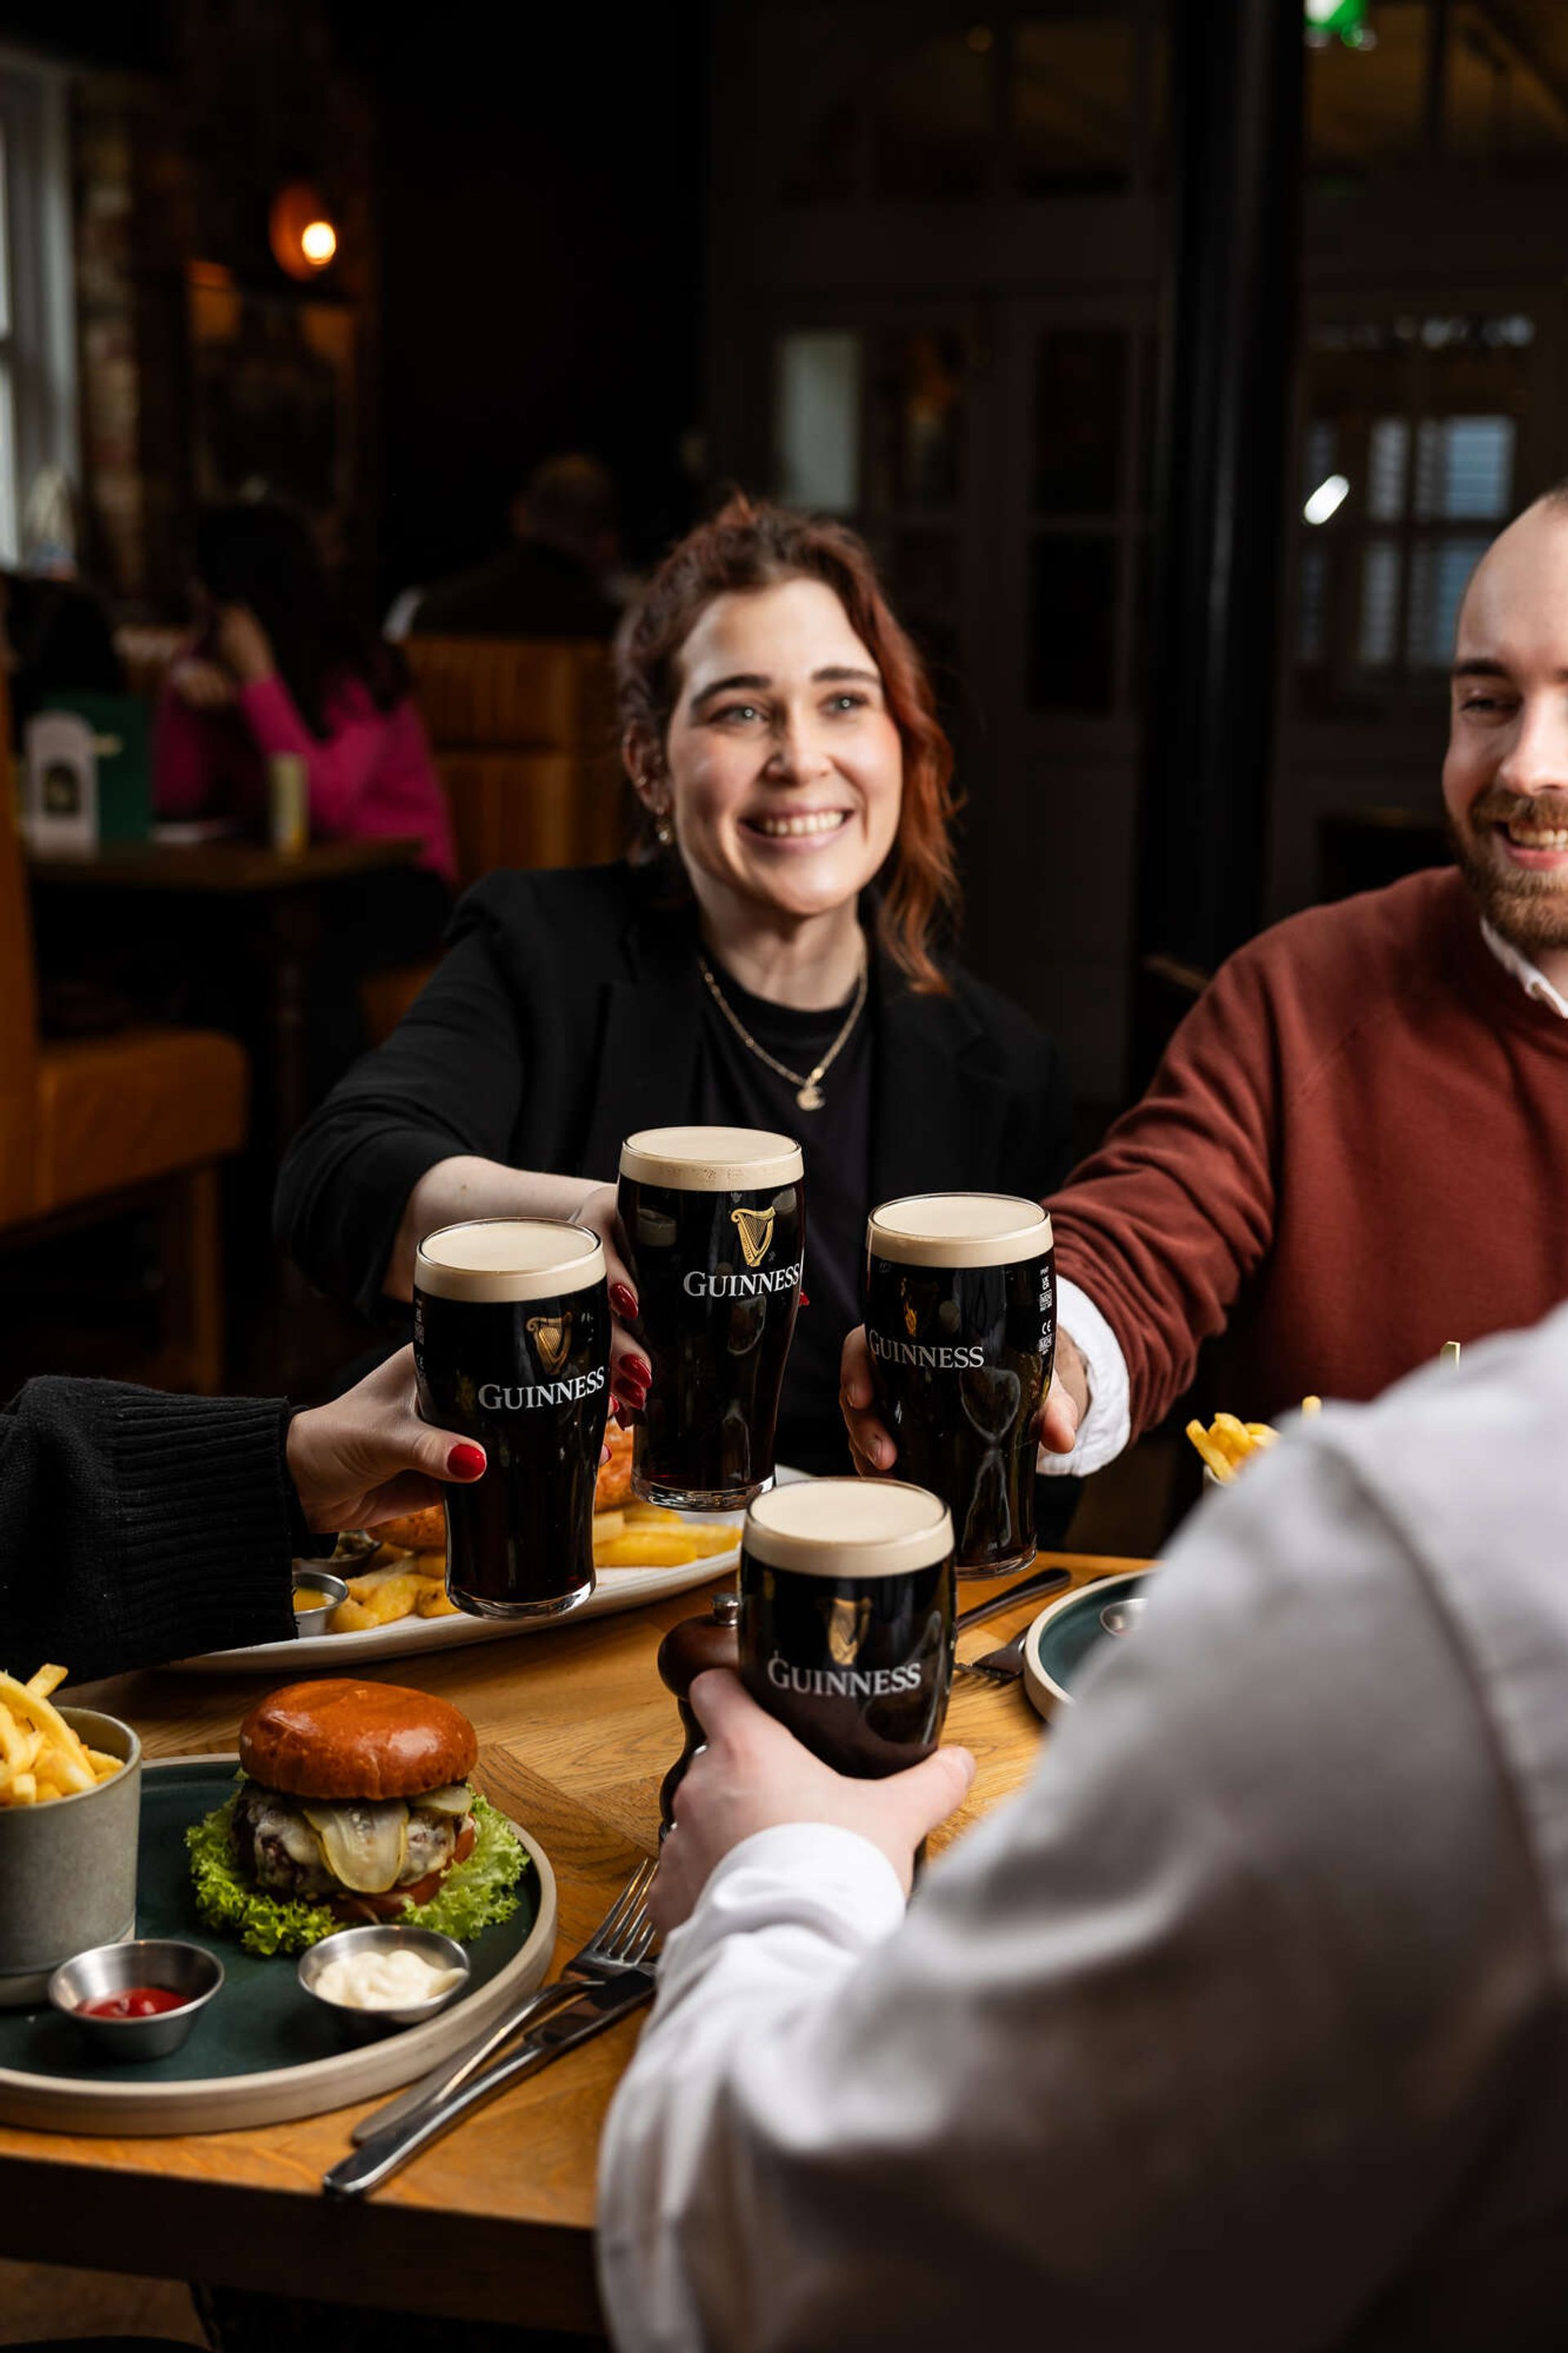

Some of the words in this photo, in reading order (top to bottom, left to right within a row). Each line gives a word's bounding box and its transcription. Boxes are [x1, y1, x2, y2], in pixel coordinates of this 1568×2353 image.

[683, 1263, 800, 1298] GUINNESS
[869, 1329, 985, 1368] GUINNESS
[478, 1366, 605, 1410] GUINNESS
[767, 1657, 922, 1697] GUINNESS
